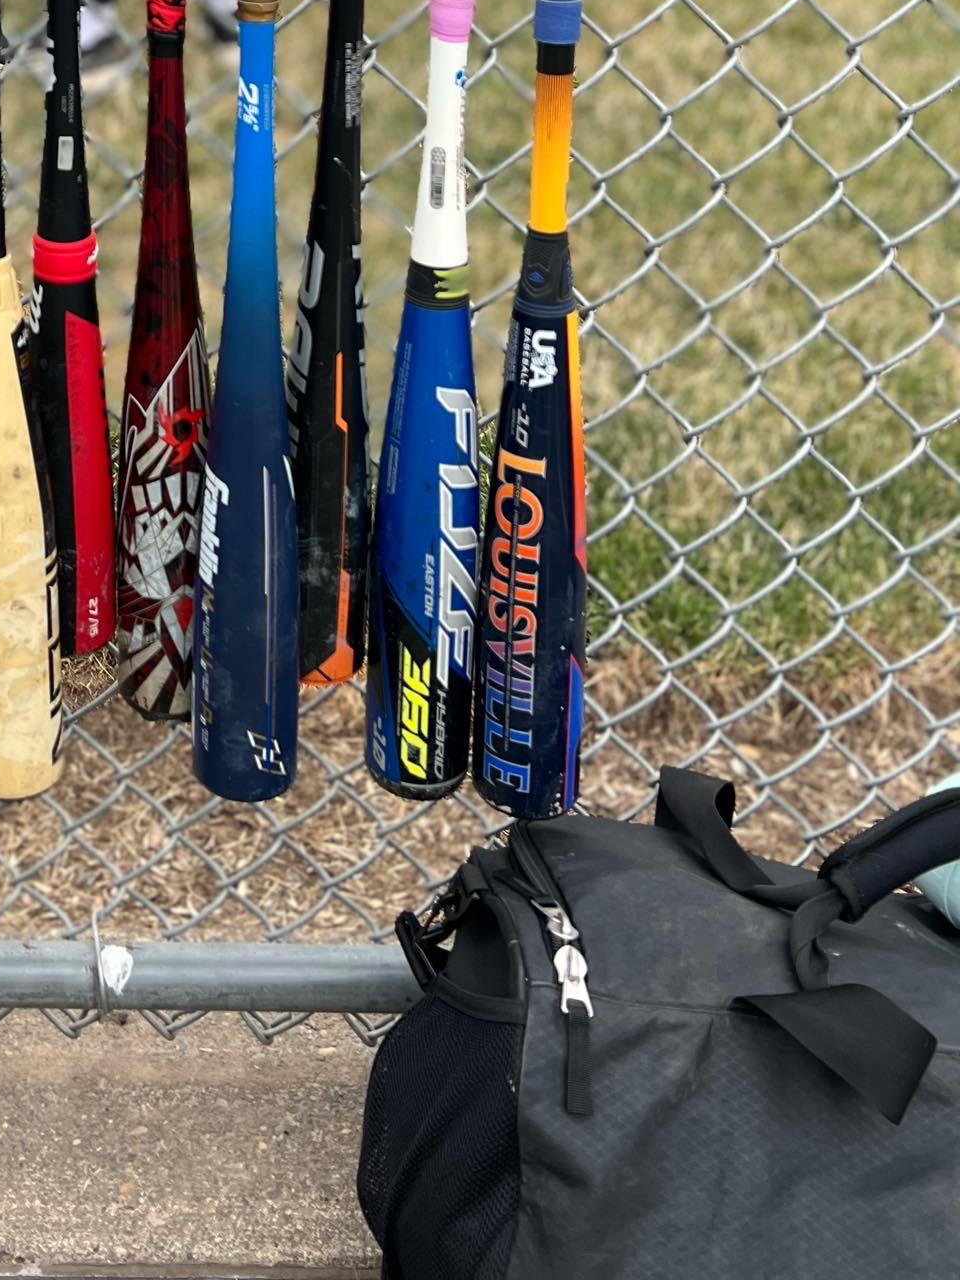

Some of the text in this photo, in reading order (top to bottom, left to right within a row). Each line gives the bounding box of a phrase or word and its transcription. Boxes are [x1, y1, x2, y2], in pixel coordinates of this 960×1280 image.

[520, 326, 532, 387] BASEBALL
[528, 329, 558, 389] USA
[515, 402, 530, 449] -10
[423, 553, 435, 619] EASTON
[483, 445, 548, 795] LOUISVILLE
[401, 645, 431, 781] 360
[434, 688, 448, 781] HYBRID
